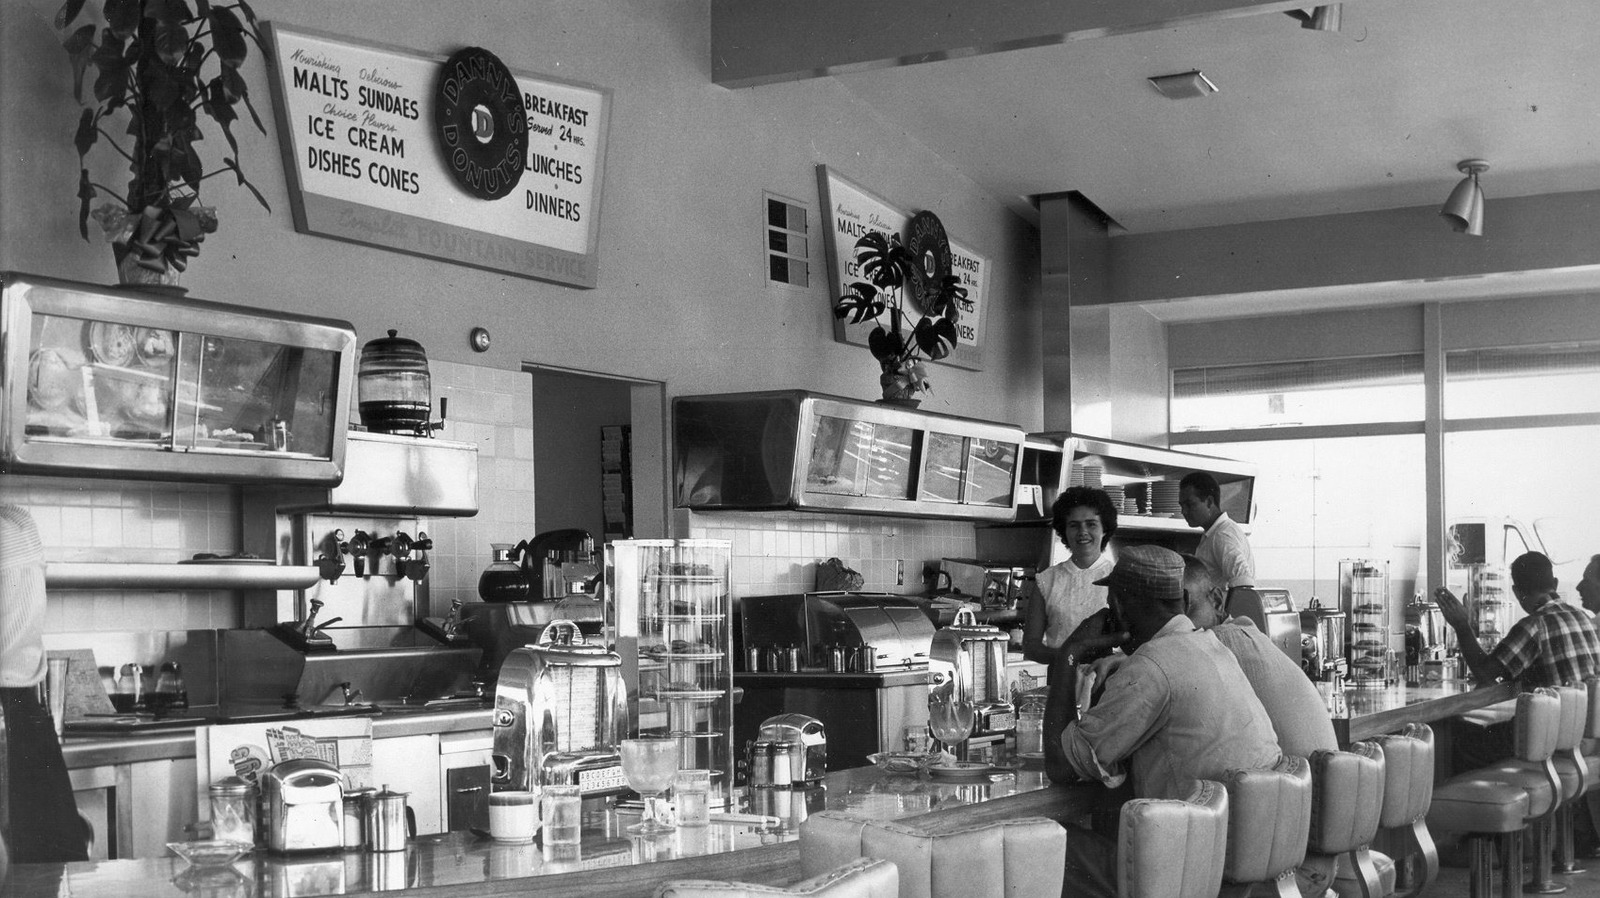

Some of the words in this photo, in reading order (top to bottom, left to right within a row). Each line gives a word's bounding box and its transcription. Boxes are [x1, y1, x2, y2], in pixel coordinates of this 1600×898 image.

[293, 65, 349, 100] MALTS
[358, 85, 419, 121] SUNDAES
[322, 102, 357, 122] Choice
[475, 108, 495, 138] D
[524, 92, 588, 127] BREAKFAST
[307, 115, 335, 140] ICE
[347, 126, 405, 159] CREAM
[527, 116, 553, 136] Served
[559, 125, 572, 143] 24
[308, 146, 362, 180] DISHES
[368, 162, 420, 195] CONES
[443, 124, 521, 194] DONUTS
[526, 189, 581, 222] DINNERS
[838, 217, 866, 238] MALTS
[844, 260, 859, 278] ICE
[963, 273, 971, 285] 24
[956, 324, 975, 340] NERS
